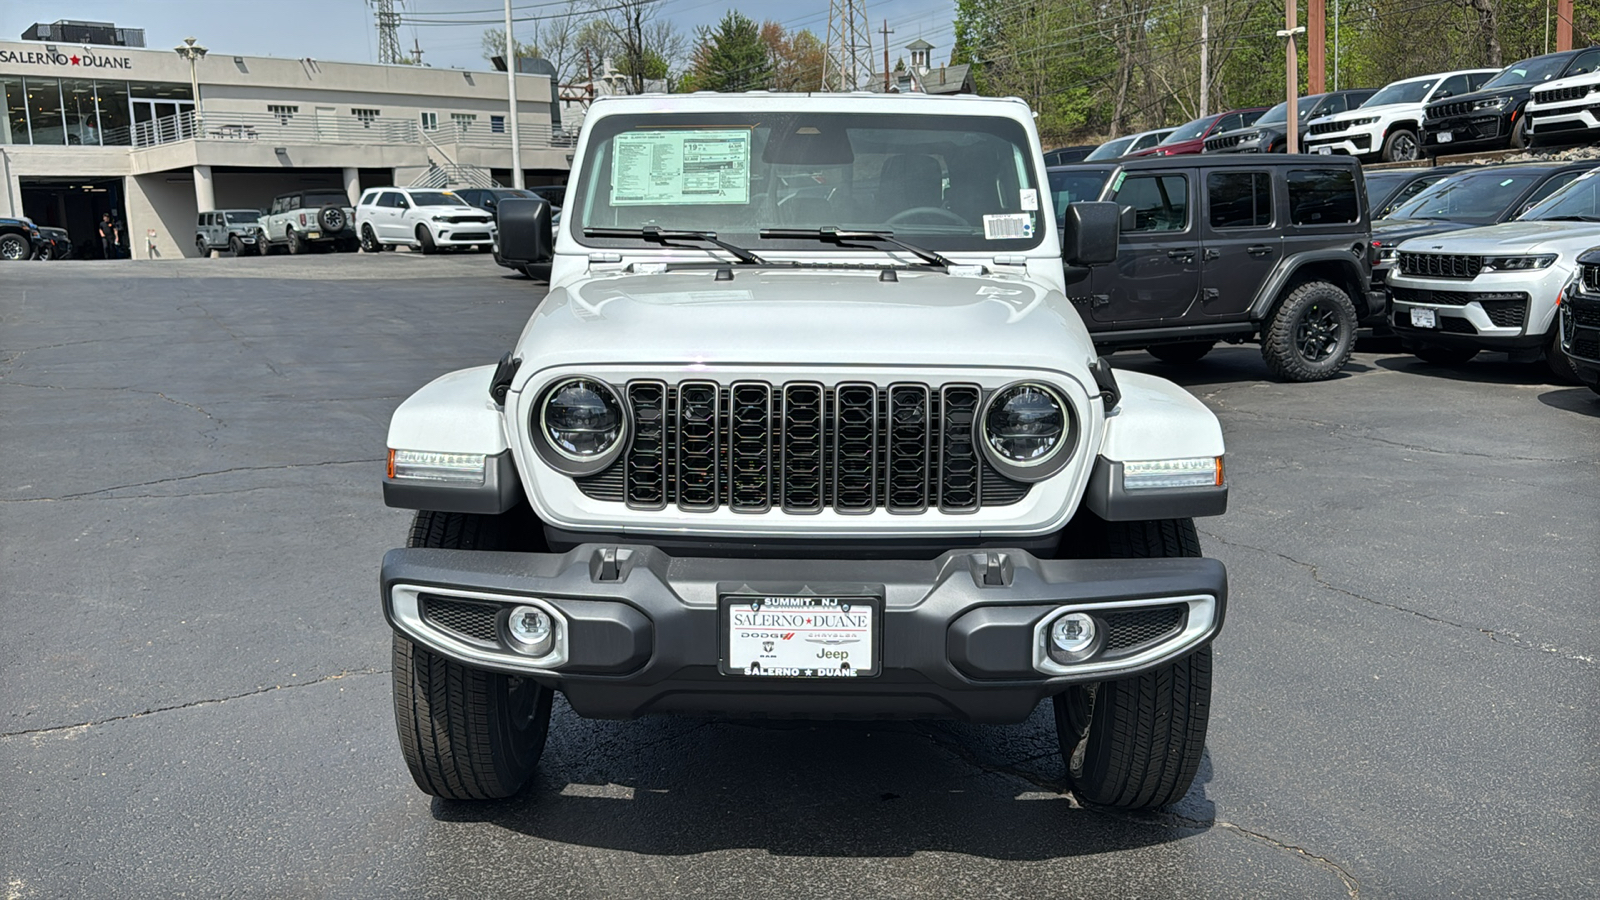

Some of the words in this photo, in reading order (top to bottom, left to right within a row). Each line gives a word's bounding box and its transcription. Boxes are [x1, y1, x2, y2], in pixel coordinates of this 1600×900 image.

[0, 50, 69, 66] SALERNO
[82, 55, 132, 69] DUANE
[764, 598, 815, 607] SUMMIT,
[821, 598, 838, 607] NJ
[734, 614, 804, 627] SALERNO
[813, 615, 867, 628] DUANE
[816, 648, 849, 661] Jeep
[744, 668, 800, 676] SALERNO
[817, 668, 858, 677] DUANE
